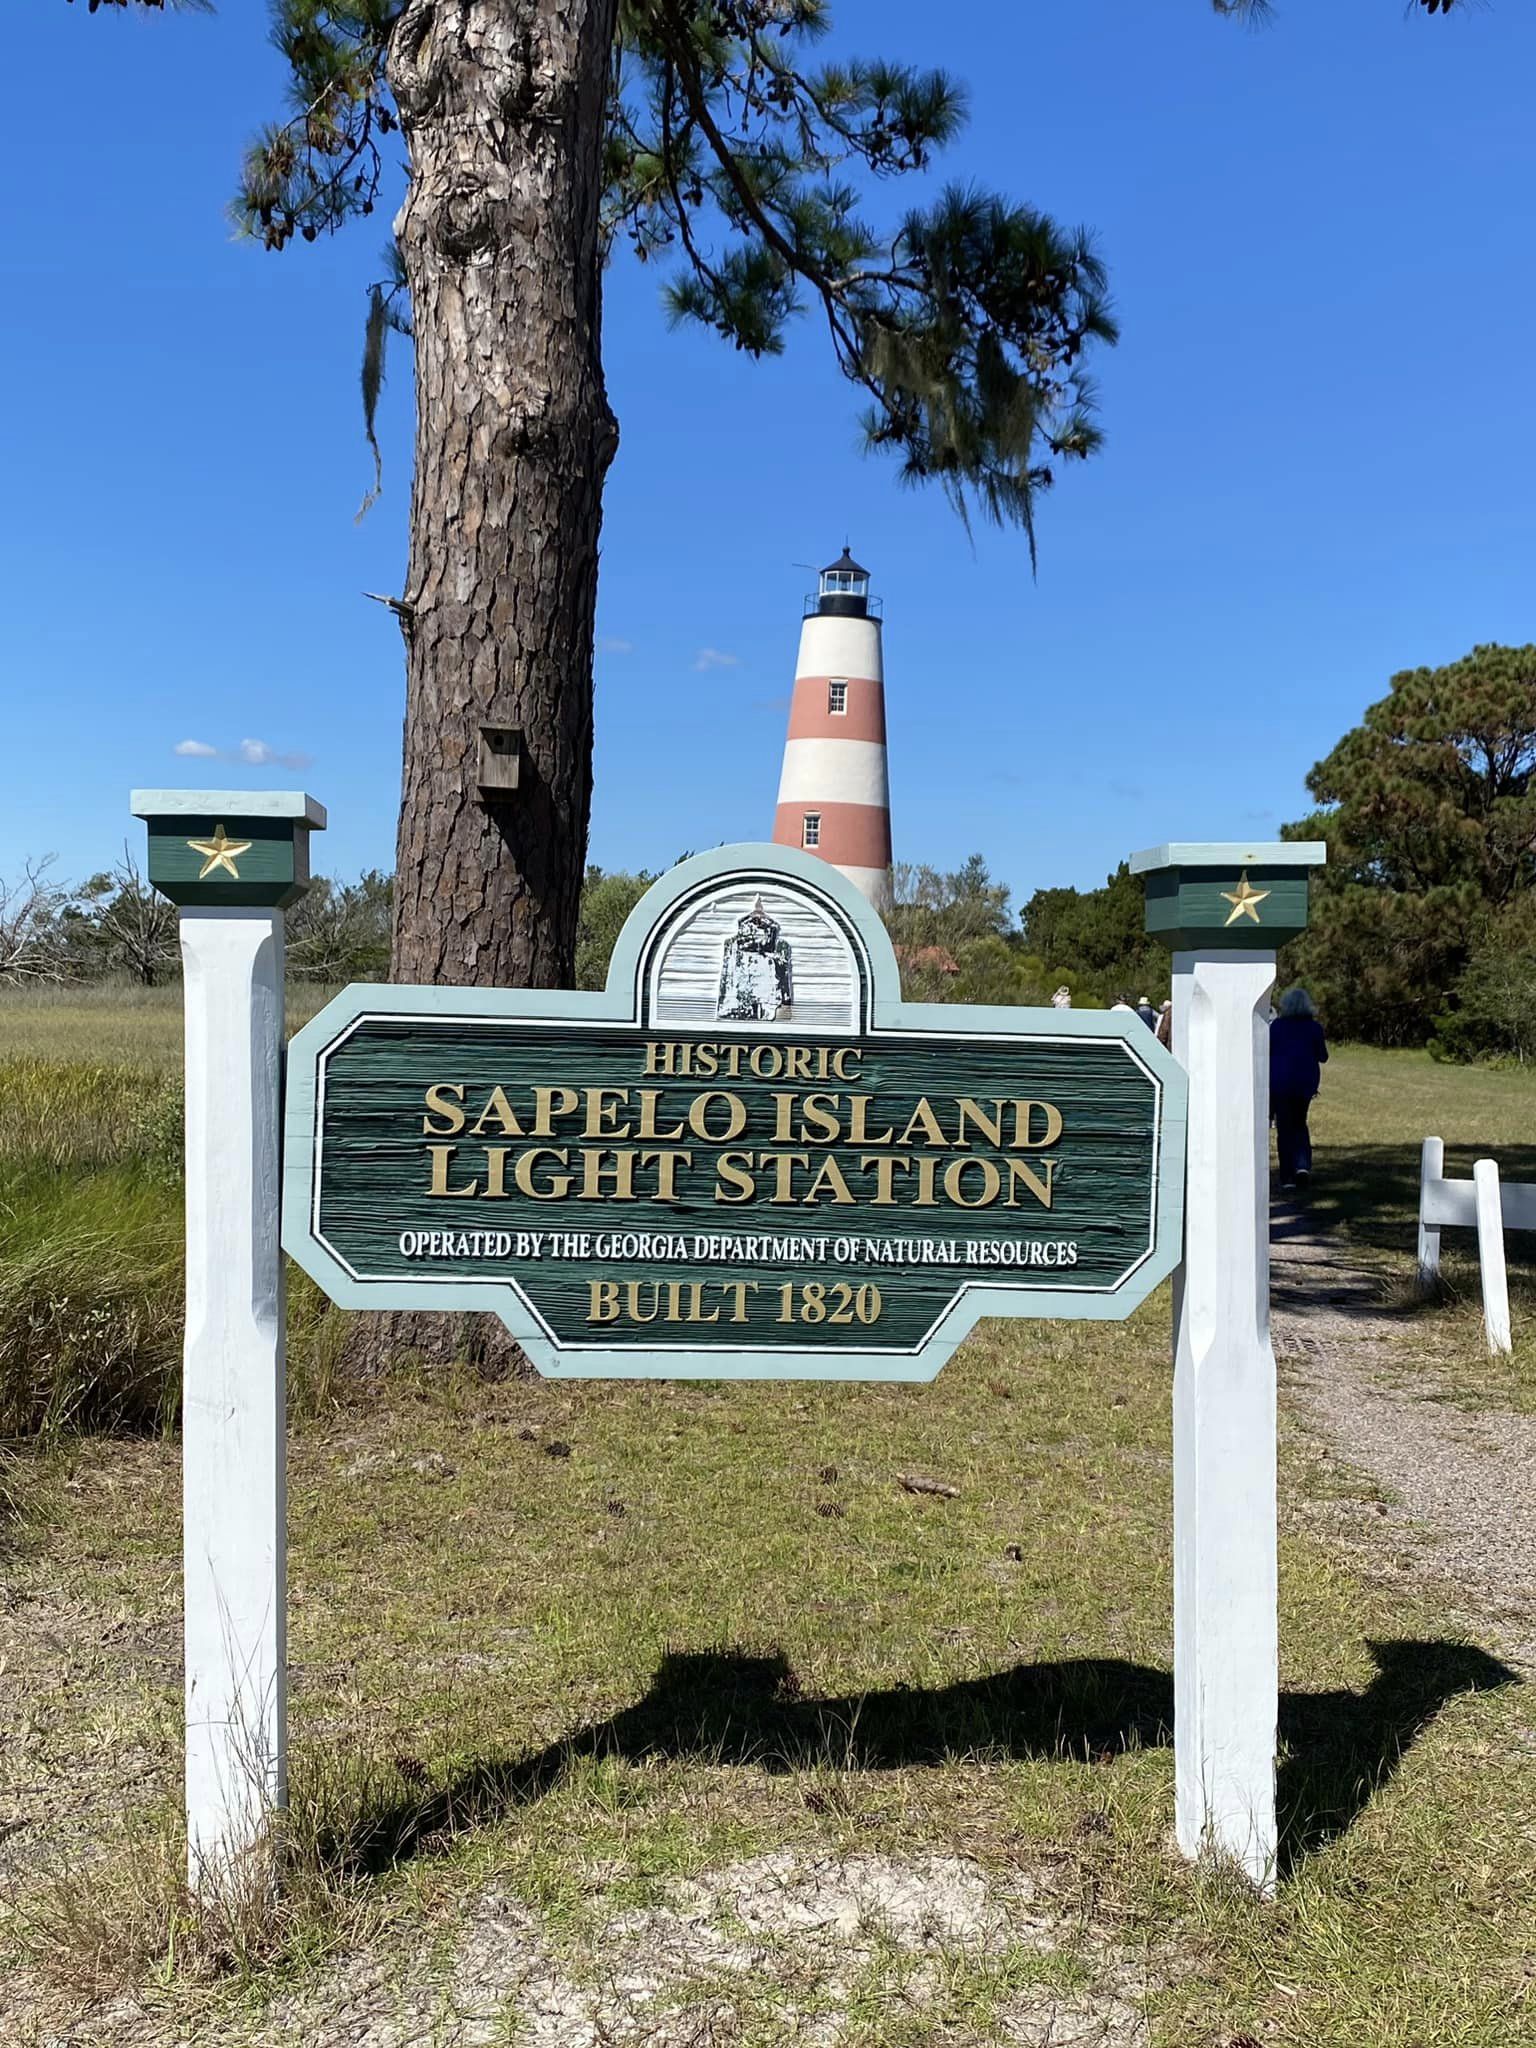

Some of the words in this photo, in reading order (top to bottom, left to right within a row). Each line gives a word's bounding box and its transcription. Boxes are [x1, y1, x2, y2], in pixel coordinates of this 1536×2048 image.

[642, 1042, 861, 1080] HISTORIC
[423, 1084, 747, 1141] SAPELO
[769, 1093, 1063, 1148] ISLAND
[425, 1145, 692, 1200] LIGHT
[715, 1152, 1058, 1208] STATION
[399, 1231, 511, 1257] OPERATED
[517, 1232, 544, 1257] BY
[549, 1233, 591, 1258] THE
[595, 1233, 689, 1260] GEORGIA
[694, 1235, 830, 1262] DEPARTMENT
[834, 1237, 860, 1262] OF
[865, 1238, 961, 1264] NATURAL
[965, 1240, 1078, 1266] RESOURCES
[585, 1280, 759, 1322] BUILT
[775, 1282, 882, 1324] 1820
